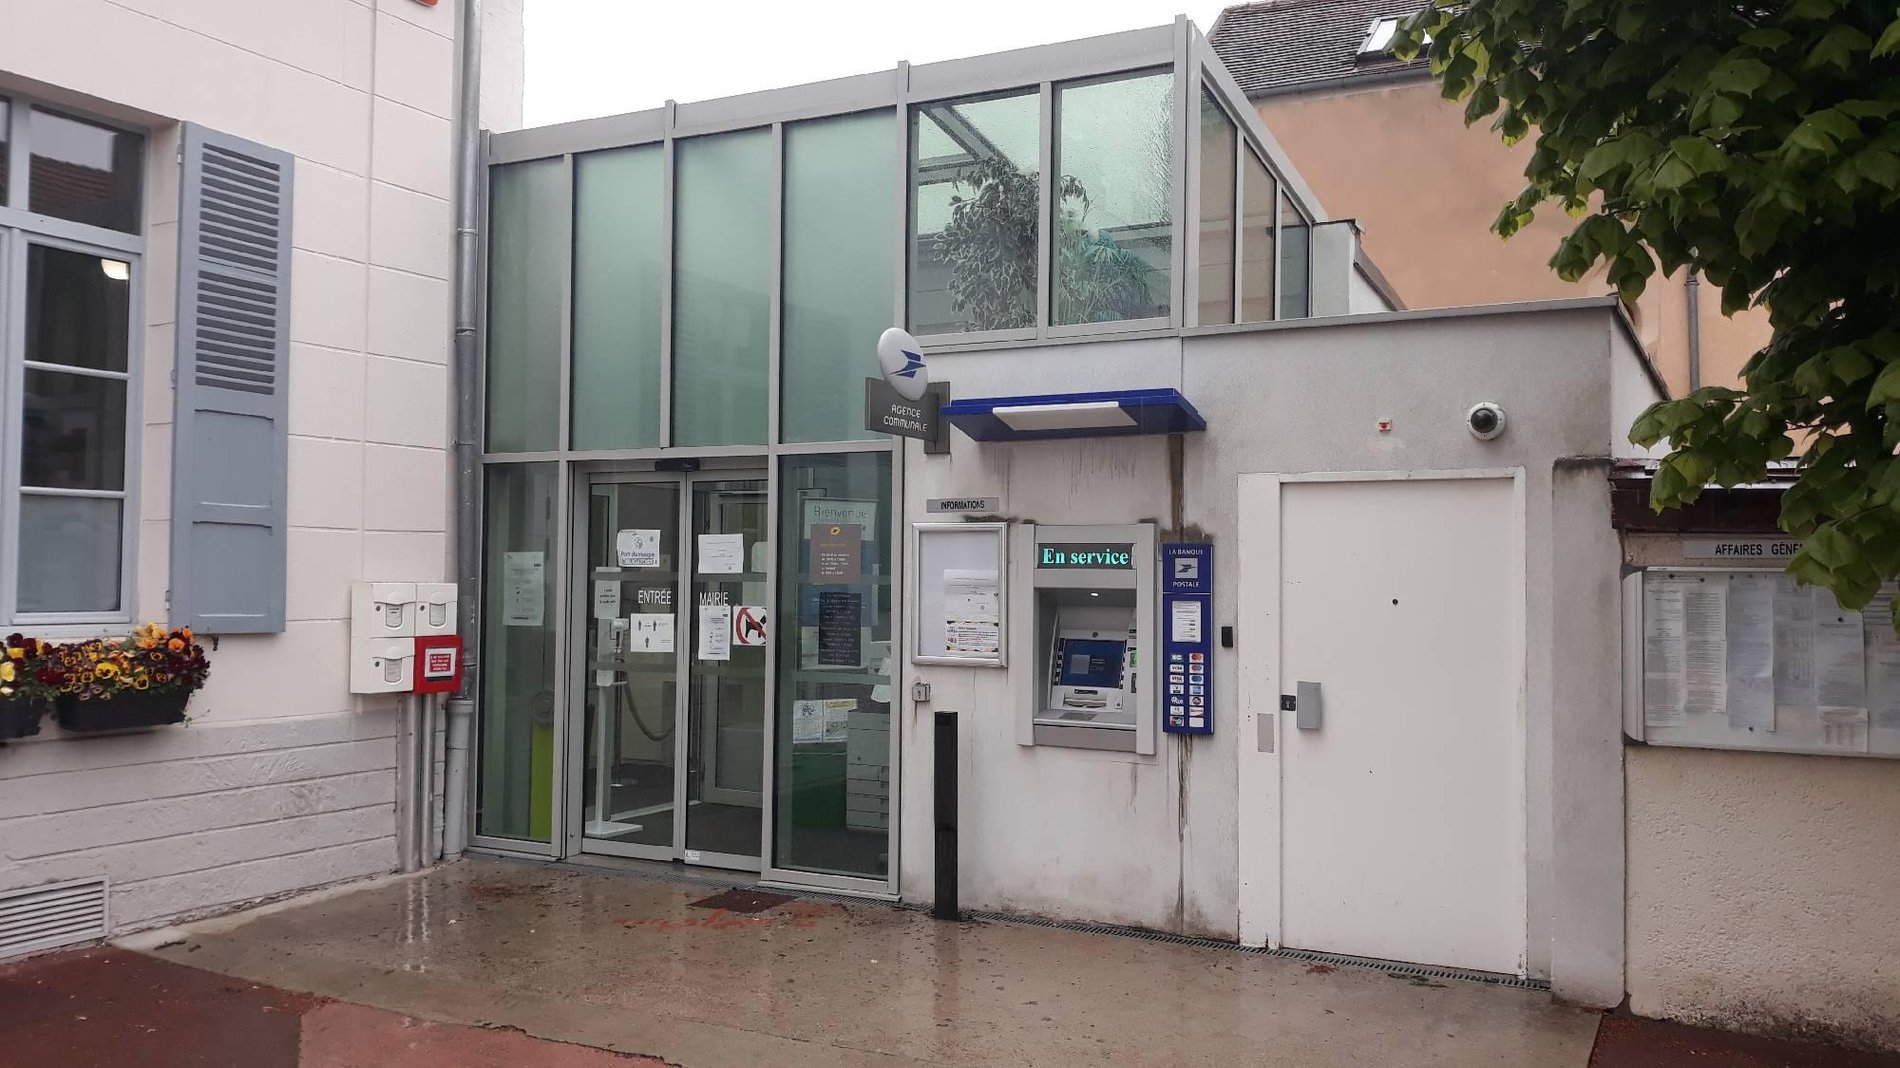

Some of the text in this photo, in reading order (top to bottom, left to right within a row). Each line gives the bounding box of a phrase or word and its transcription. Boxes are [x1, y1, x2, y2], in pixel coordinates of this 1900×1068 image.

[891, 404, 921, 418] AGENCE
[883, 415, 927, 432] COMMUNALE
[940, 500, 985, 510] INFORMATIONS
[1715, 541, 1803, 556] AFFAIRES GÉNÉ
[1042, 548, 1129, 565] En service
[638, 589, 672, 605] ENTRÉE
[699, 591, 729, 606] MAIRIE
